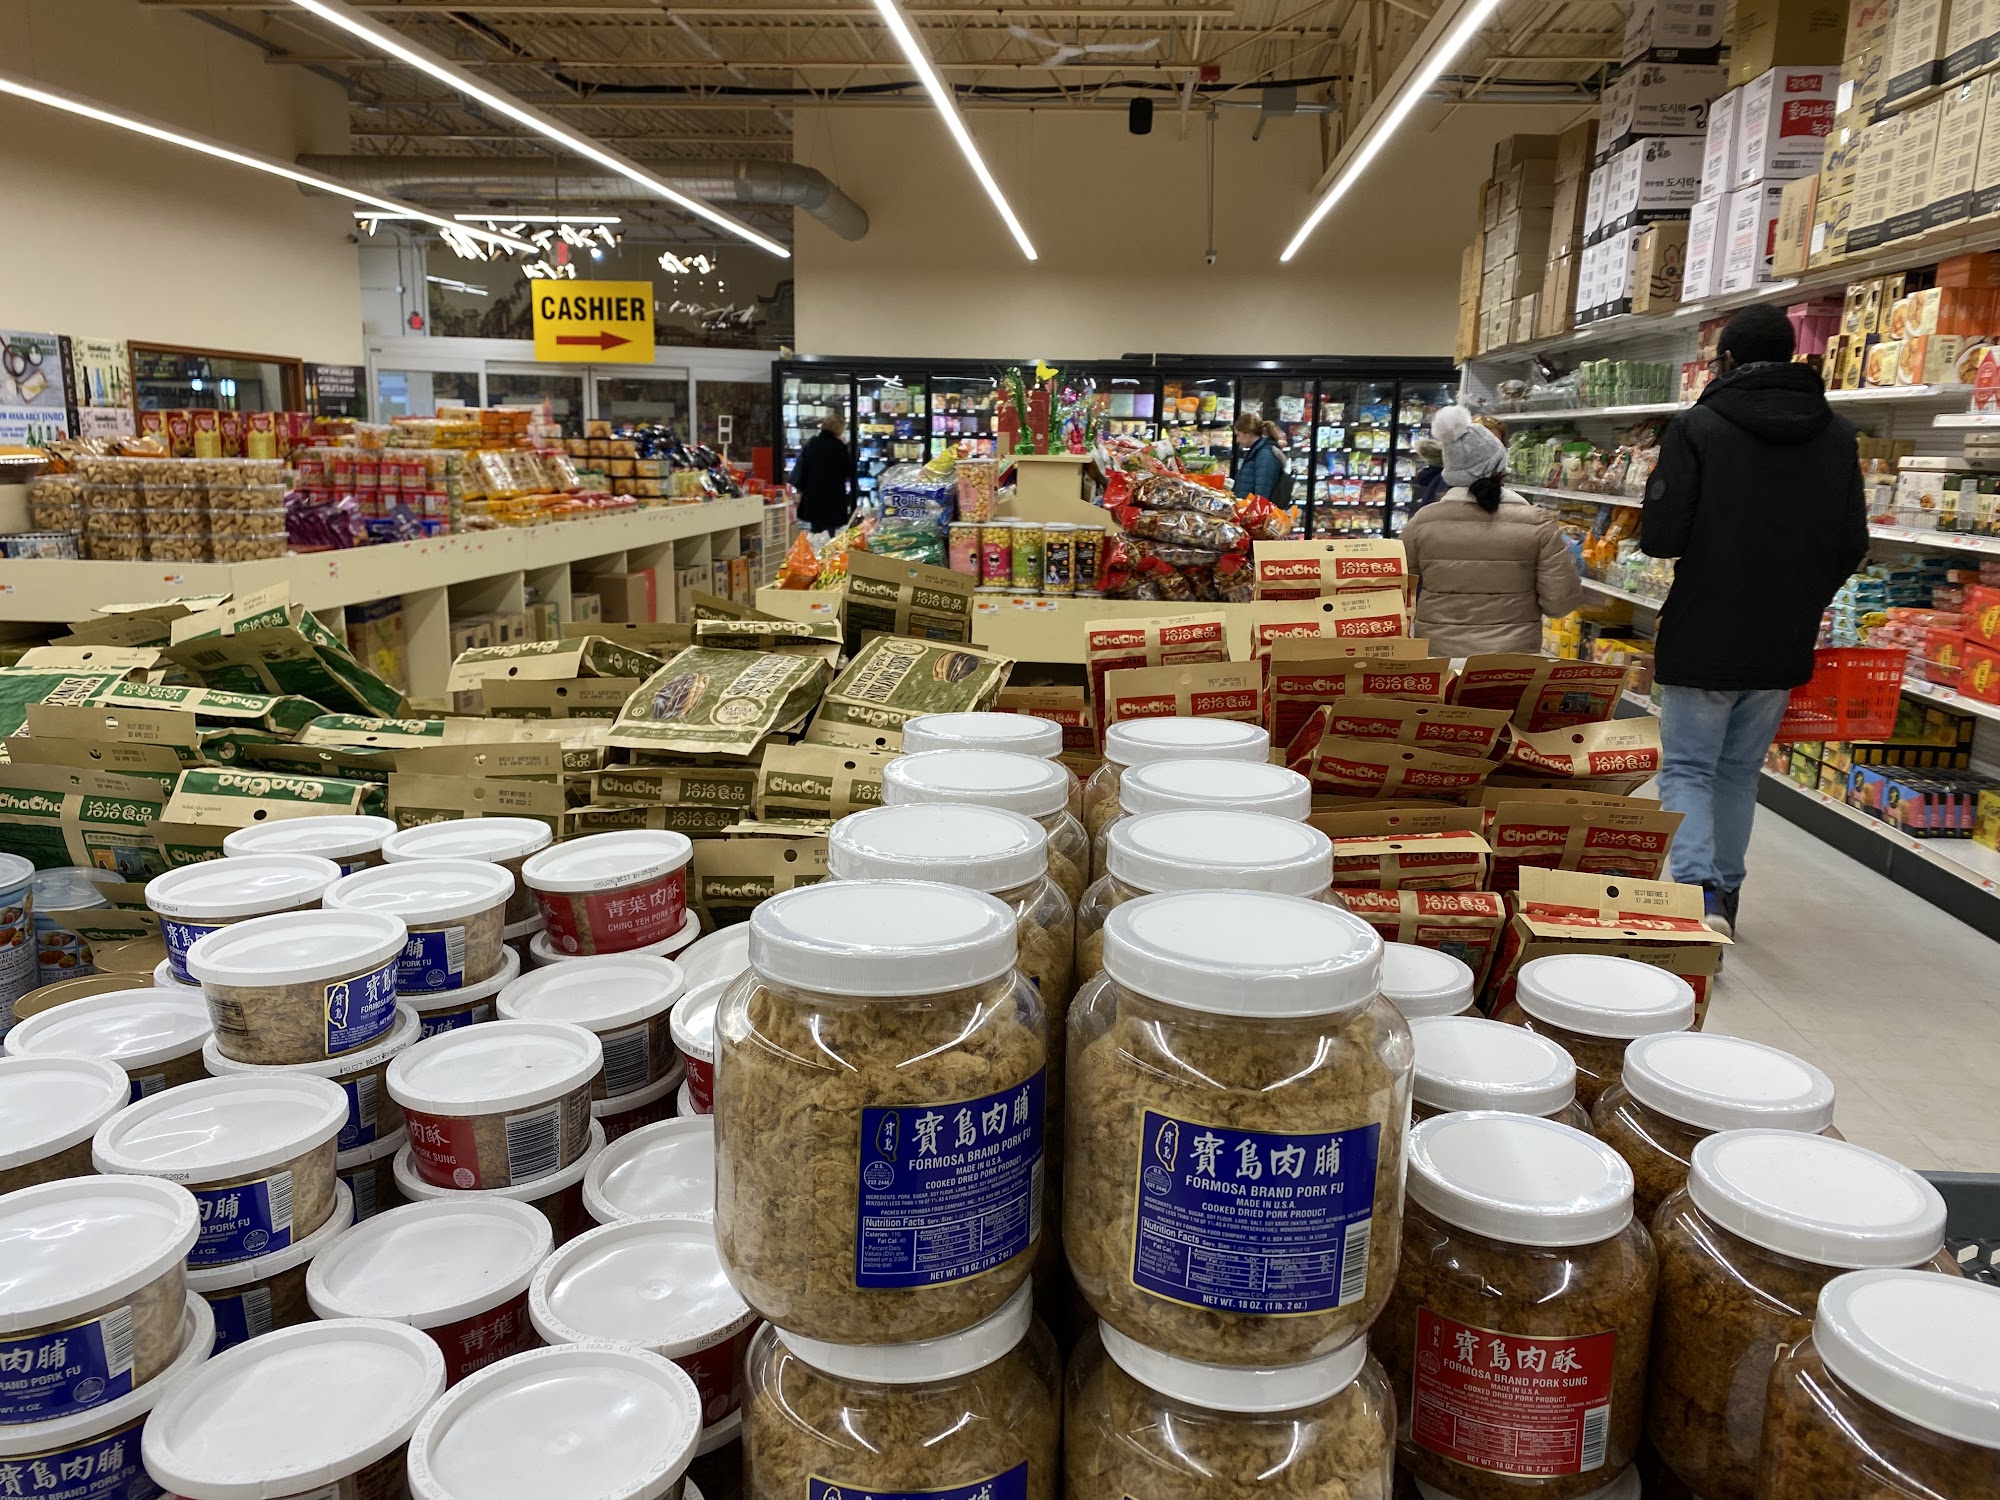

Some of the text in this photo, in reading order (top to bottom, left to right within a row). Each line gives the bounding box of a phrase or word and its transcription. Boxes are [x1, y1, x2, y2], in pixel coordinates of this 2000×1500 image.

[541, 296, 645, 322] CASHIER
[1264, 564, 1321, 577] ChaCha
[1341, 561, 1396, 575] 洽洽食品
[852, 578, 899, 599] ChaCha
[916, 591, 962, 611] 洽洽食品
[1165, 627, 1217, 642] 洽洽食品
[1341, 620, 1396, 636] 洽洽食品
[1093, 634, 1146, 647] ChaCha
[1281, 679, 1346, 692] ChaCha
[1370, 676, 1433, 691] 洽洽食品
[1120, 701, 1177, 715] ChaCha
[1197, 695, 1251, 710] 洽洽食品
[1336, 720, 1400, 735] ChaCha
[1323, 761, 1387, 779] ChaCha
[1595, 754, 1652, 772] 洽洽食品
[218, 775, 324, 801] ChaCha
[601, 777, 663, 796] ChaCha
[685, 782, 745, 801] 洽洽食品
[769, 776, 832, 797] ChaCha
[86, 801, 152, 821] 洽洽食品
[671, 809, 732, 827] 洽洽食品
[1502, 829, 1569, 842] ChaCha
[1593, 831, 1658, 849] 洽洽食品
[706, 882, 775, 898] ChaCha
[1344, 892, 1400, 907] haCha
[1425, 894, 1490, 912] 洽洽食品
[608, 920, 633, 932] CHING
[635, 916, 650, 927] YEH
[651, 909, 669, 922] PORK
[402, 958, 432, 968] PORK FU
[908, 1126, 1032, 1171] FORMOSA BRAND PORK FU
[432, 1152, 457, 1165] SUNG
[925, 1155, 1022, 1190] COOKED DRIED PORK PRODUCT
[956, 1164, 976, 1176] MADE
[977, 1161, 985, 1171] IN
[1185, 1175, 1247, 1196] FORMOSA
[1251, 1185, 1293, 1198] BRAND
[1296, 1184, 1328, 1197] PORK
[1330, 1182, 1345, 1195] FU
[1201, 1202, 1327, 1219] COOKED DRIED PORK PRODUCT
[1236, 1198, 1297, 1209] MADE IN U.S.A.
[209, 1217, 251, 1235] PORK FU
[865, 1216, 925, 1228] Nutrition Facts
[1143, 1219, 1200, 1244] Nutrition Facts
[930, 1271, 945, 1281] NET
[946, 1268, 960, 1279] WT.
[961, 1265, 970, 1275] 18
[970, 1262, 983, 1273] OZ.
[1203, 1294, 1308, 1311] NET WT. 18 OZ. (1 lb. 2 oz.)
[696, 1319, 740, 1350] 05U26 BEST
[461, 1352, 495, 1374] CHING
[31, 1365, 81, 1387] PORK FU
[1443, 1357, 1588, 1388] FORMOSA BRAND PORK SUNG
[1463, 1383, 1566, 1404] COOKED DRIED PORK PRODUCT
[1490, 1382, 1510, 1393] MADE
[1512, 1386, 1520, 1394] IN
[1467, 1454, 1481, 1465] NET
[1496, 1461, 1504, 1470] 18
[49, 1465, 136, 1500] BRAND PORK FU
